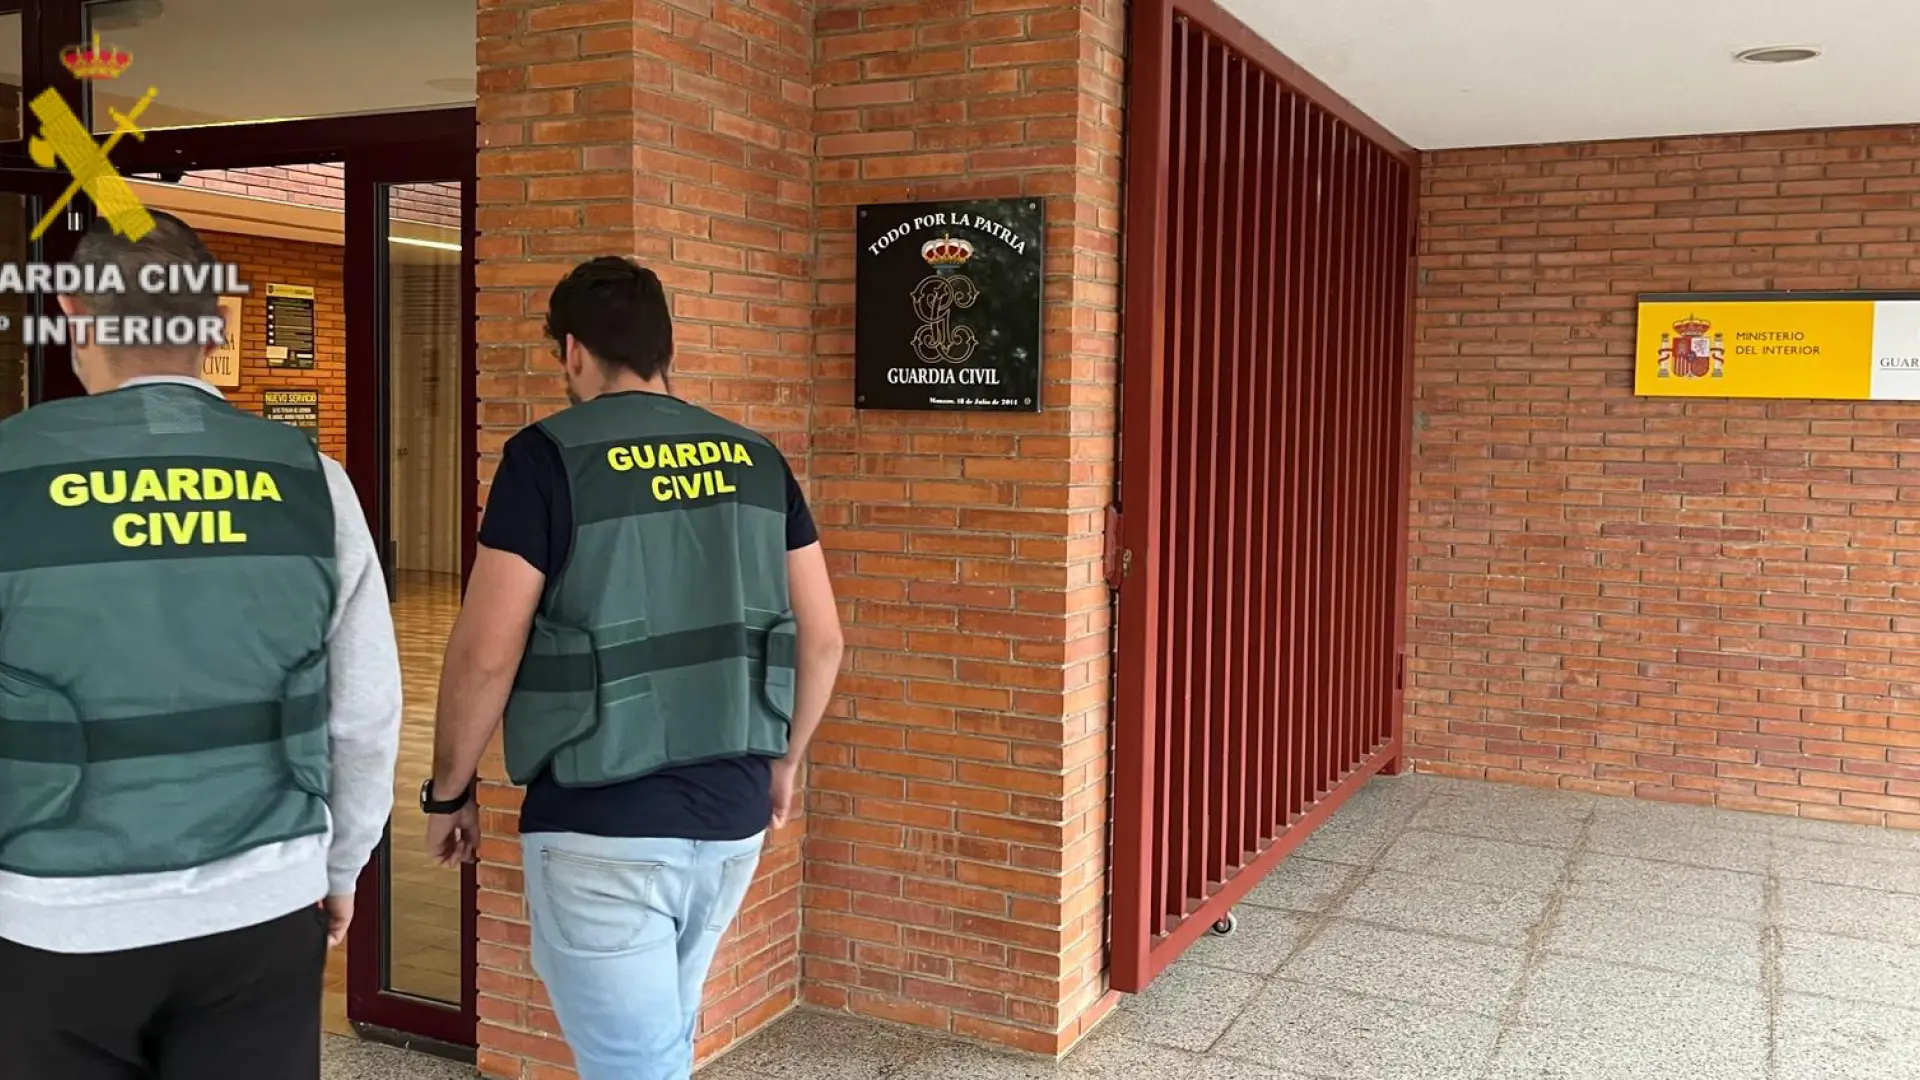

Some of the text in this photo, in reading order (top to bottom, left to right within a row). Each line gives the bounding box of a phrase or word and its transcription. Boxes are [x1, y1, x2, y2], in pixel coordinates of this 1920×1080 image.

[868, 212, 1026, 256] TODO POR LA PATRIA
[1735, 345, 1820, 355] DEL INTERIOR
[1736, 331, 1805, 341] MINISTERIO
[203, 355, 232, 376] CIVIL
[887, 367, 1000, 385] GUARDIA CIVIL
[607, 440, 754, 472] GUARDIA
[49, 467, 283, 507] GUARDIA
[651, 469, 737, 502] CIVIL
[112, 510, 248, 548] CIVIL
